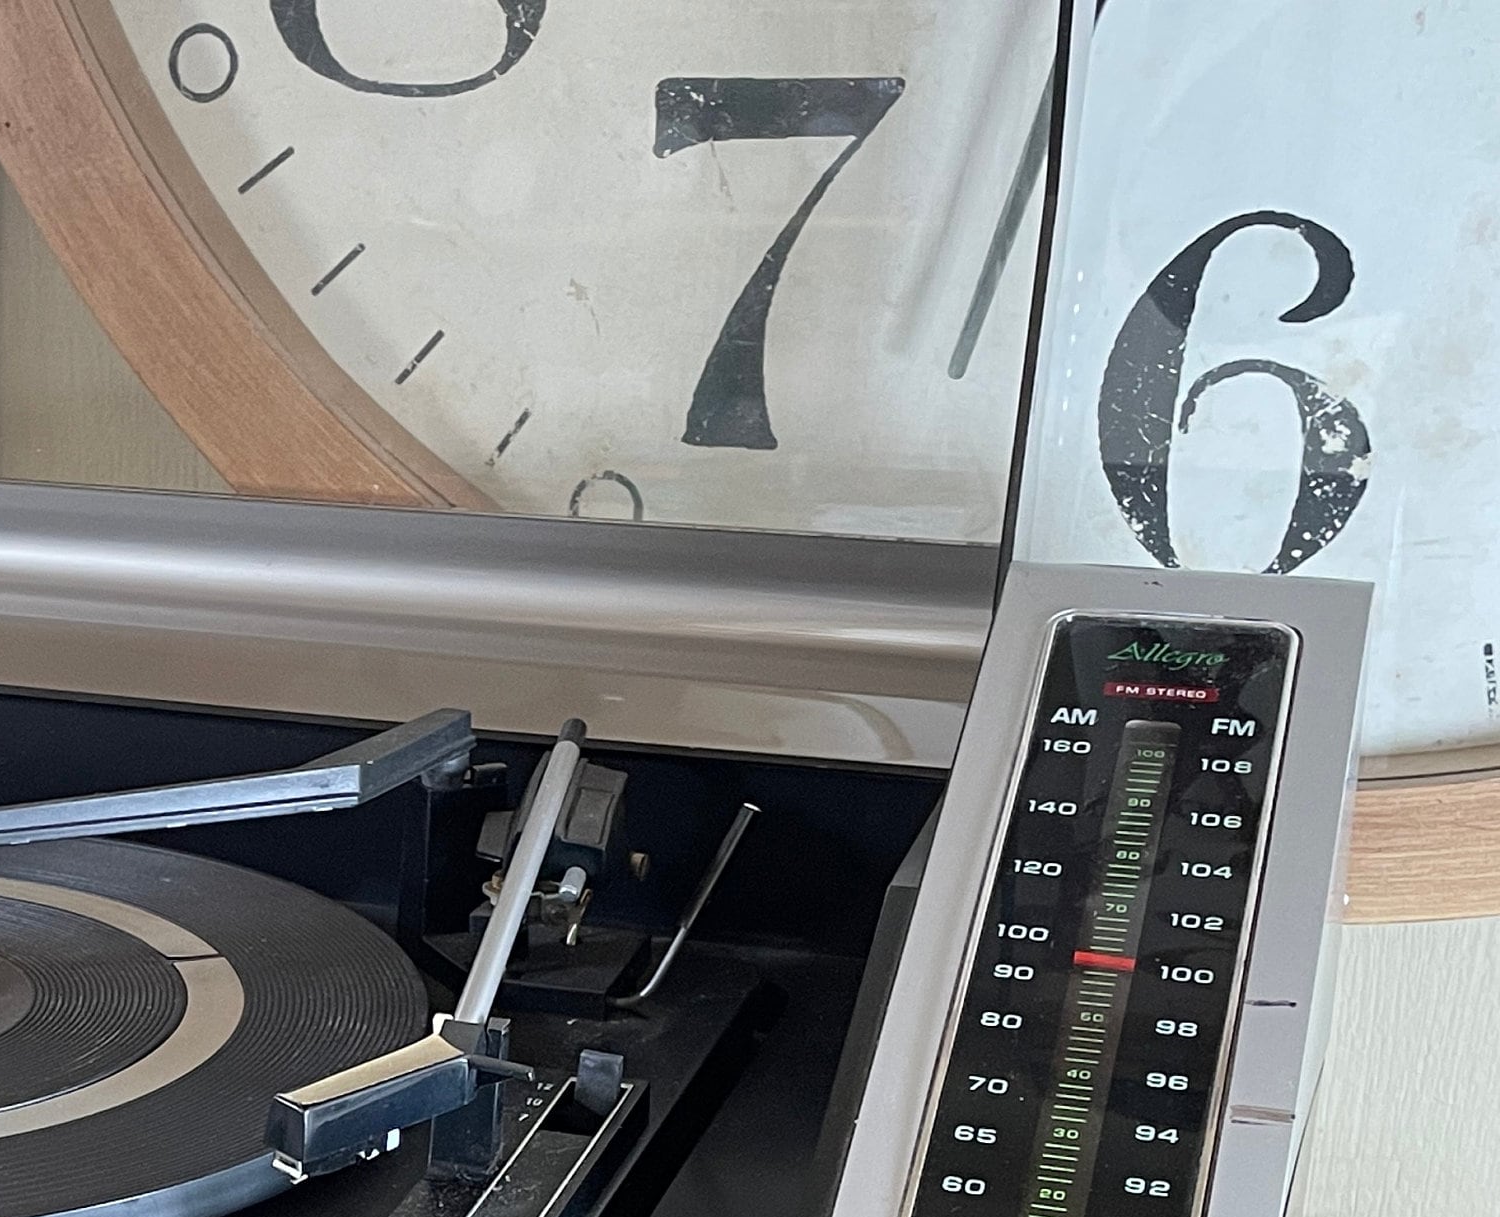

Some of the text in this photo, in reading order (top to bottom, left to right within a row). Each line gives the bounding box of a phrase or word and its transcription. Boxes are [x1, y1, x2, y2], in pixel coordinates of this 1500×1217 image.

[655, 78, 904, 449] 7
[1099, 210, 1371, 575] 6
[1108, 641, 1230, 670] Allegro
[1116, 685, 1206, 699] FM STEREO
[1051, 707, 1098, 726] AM
[1211, 718, 1255, 737] FM
[1043, 738, 1091, 754] 160
[1137, 749, 1165, 759] 100
[1200, 758, 1252, 774] 108
[1028, 800, 1077, 816] 140
[1128, 798, 1151, 808] 90
[1190, 812, 1242, 828] 106
[1116, 851, 1140, 860] 80
[1013, 859, 1062, 877] 120
[1181, 863, 1233, 879] 104
[1105, 904, 1127, 914] 70
[1170, 913, 1224, 931] 102
[997, 924, 1049, 942] 100
[993, 965, 1034, 981] 90
[1160, 966, 1214, 984] 100
[980, 1011, 1022, 1030] 80
[1155, 1019, 1197, 1037] 98
[1067, 1070, 1091, 1080] 40
[1146, 1073, 1188, 1091] 96
[968, 1076, 1008, 1094] 70
[526, 1097, 543, 1106] 10
[954, 1126, 997, 1143] 65
[1053, 1129, 1079, 1139] 30
[1135, 1125, 1179, 1143] 94
[942, 1177, 985, 1195] 60
[1040, 1189, 1066, 1200] 20
[1125, 1178, 1170, 1197] 92
